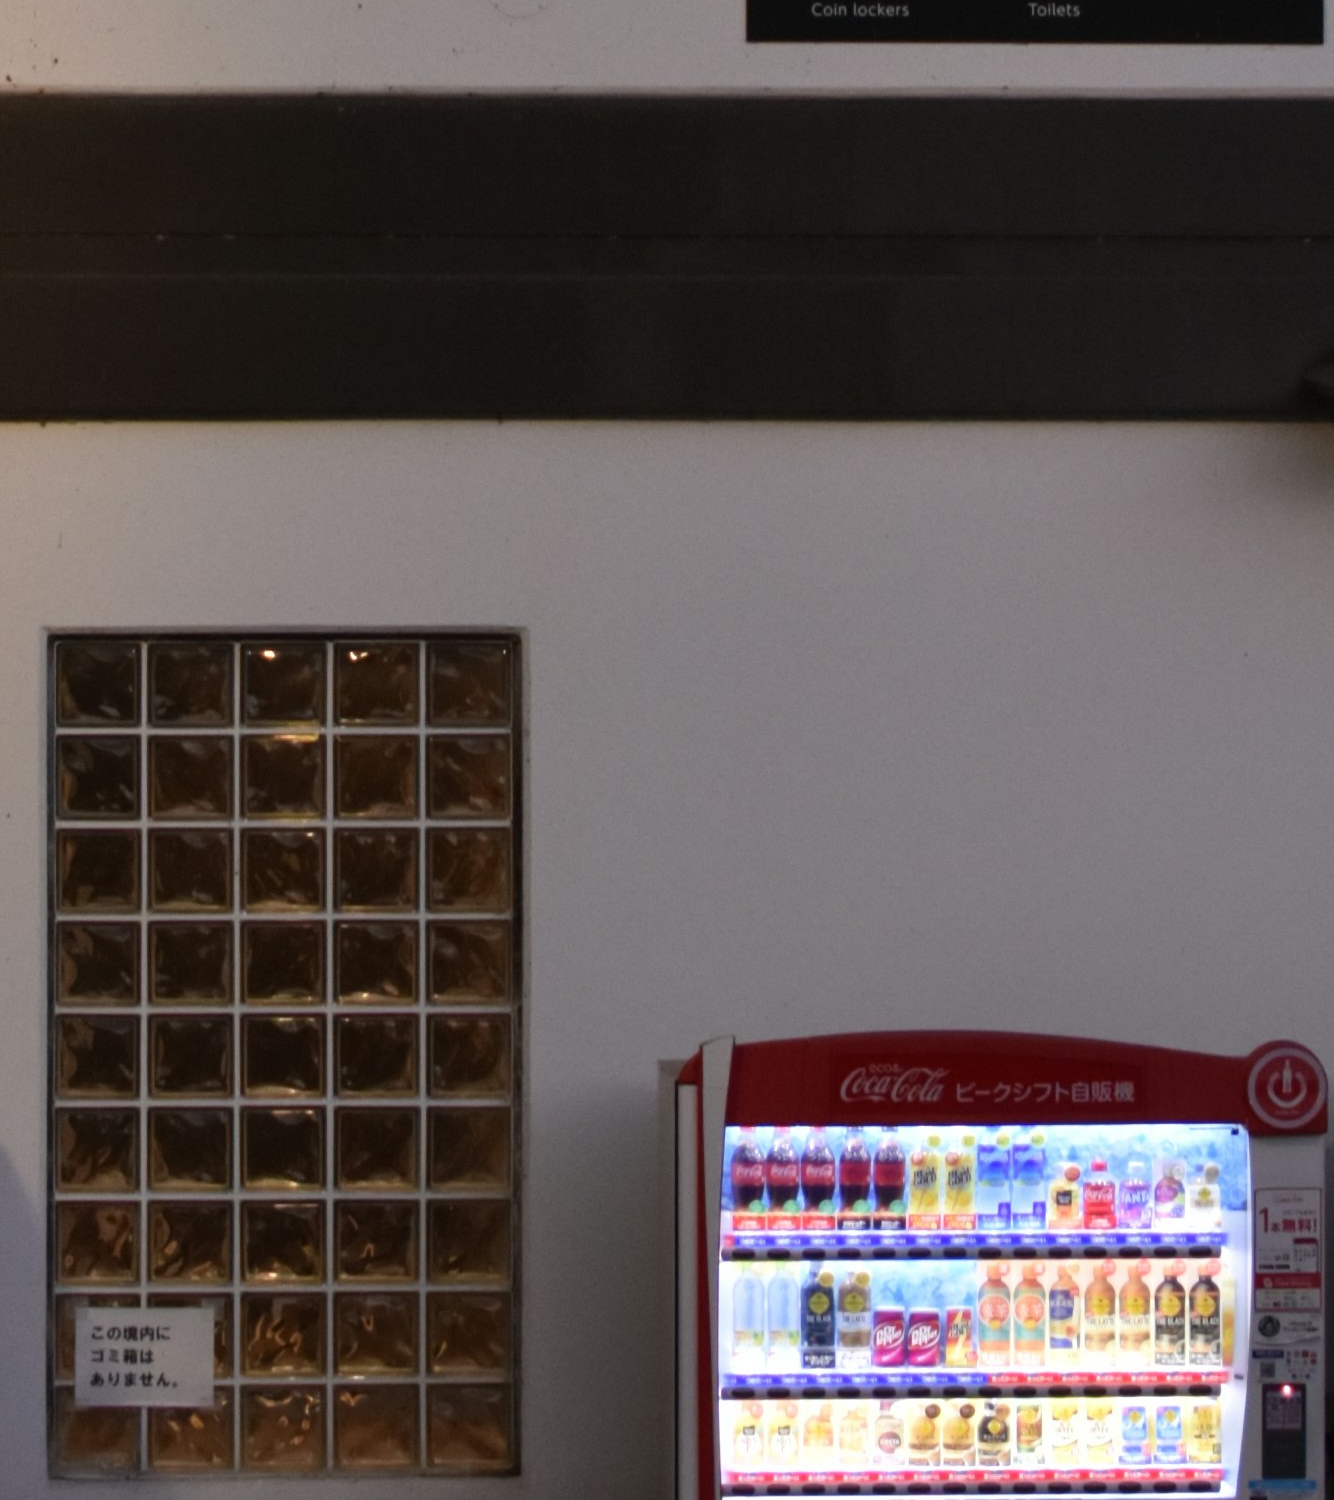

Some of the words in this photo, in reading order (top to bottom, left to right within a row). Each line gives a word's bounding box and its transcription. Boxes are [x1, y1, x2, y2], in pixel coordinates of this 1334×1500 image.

[811, 2, 847, 18] Coin
[853, 2, 910, 18] lockers
[1028, 2, 1081, 18] Toilets
[840, 1066, 951, 1102] Coca-Cola
[91, 1326, 171, 1342] この境内に
[91, 1349, 155, 1364] ゴミ箱は
[91, 1372, 179, 1388] ありません。
